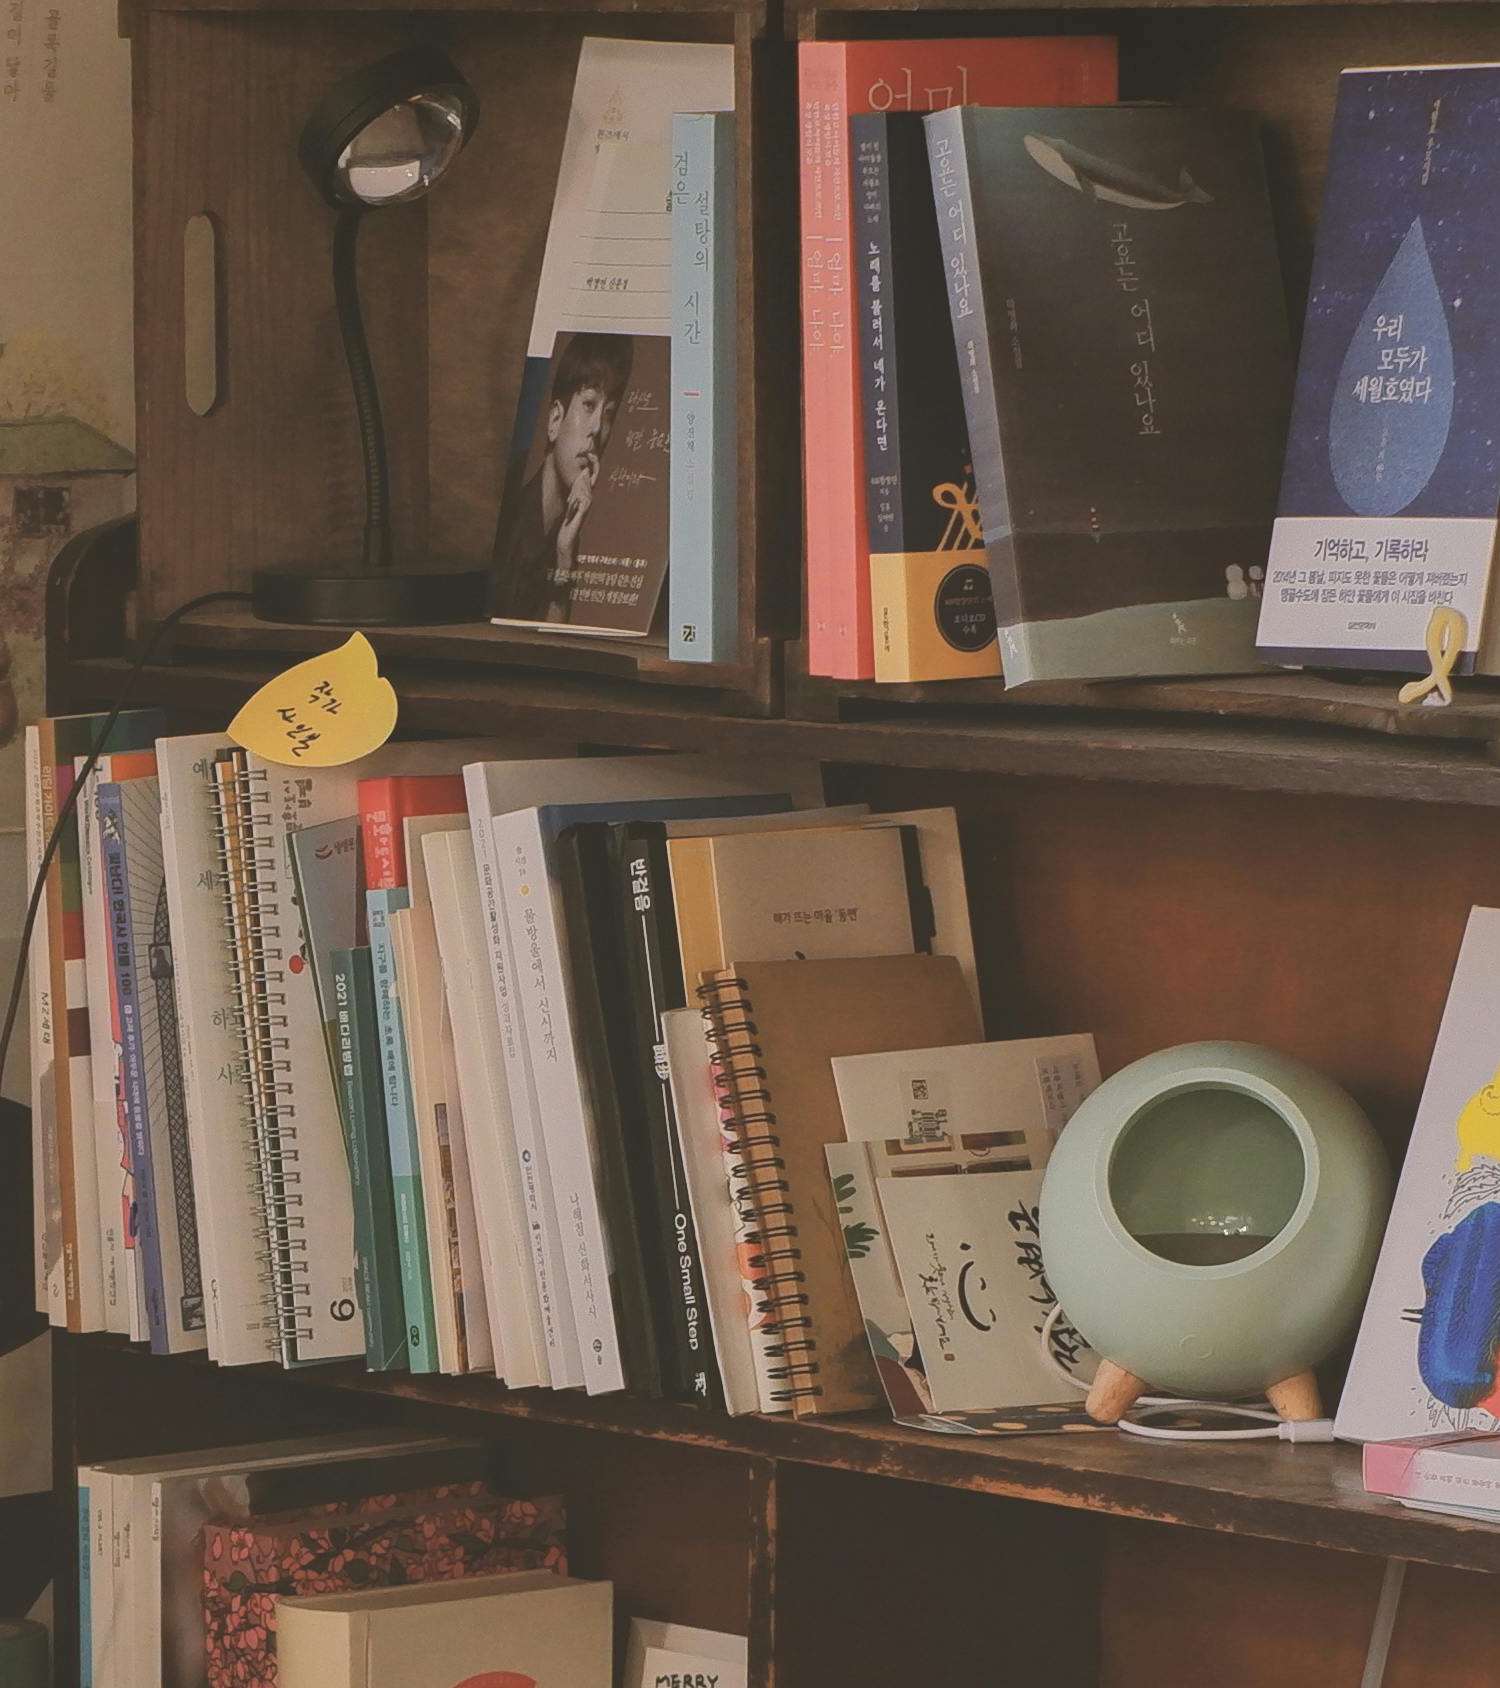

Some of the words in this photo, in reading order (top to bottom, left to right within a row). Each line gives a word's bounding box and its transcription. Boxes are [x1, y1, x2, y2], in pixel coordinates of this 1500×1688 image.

[673, 151, 690, 205] 검은
[936, 139, 957, 198] 고요는
[694, 190, 711, 272] 설탕의
[949, 199, 966, 245] 어디
[868, 240, 881, 293] 노래를
[1111, 223, 1139, 292] 고요는
[951, 253, 974, 319] 있나요
[683, 291, 701, 345] 시간
[870, 299, 883, 351] 불러서
[1131, 299, 1156, 352] 어디
[1372, 314, 1404, 342] 우리
[872, 357, 886, 392] 네가
[1377, 345, 1429, 373] 모두가
[1130, 360, 1161, 435] 있나요
[1352, 376, 1433, 404] 세월호였다
[875, 400, 888, 453] 온다면
[1314, 538, 1370, 564] 기억하고,
[1374, 538, 1429, 563] 기록하라
[1328, 571, 1352, 584] 피지도
[1354, 571, 1372, 585] 못한
[308, 680, 342, 715] 작가
[477, 819, 487, 857] 2021
[630, 857, 651, 912] 반걸음
[120, 971, 131, 997] 100
[378, 943, 388, 974] 지구를
[335, 973, 347, 1005] 2021
[523, 908, 547, 991] 물방울에서
[537, 997, 558, 1063] 신시까지
[339, 1008, 352, 1076] 배다리빙랩
[673, 1212, 688, 1245] One
[677, 1248, 695, 1309] Small
[683, 1312, 700, 1351] Step
